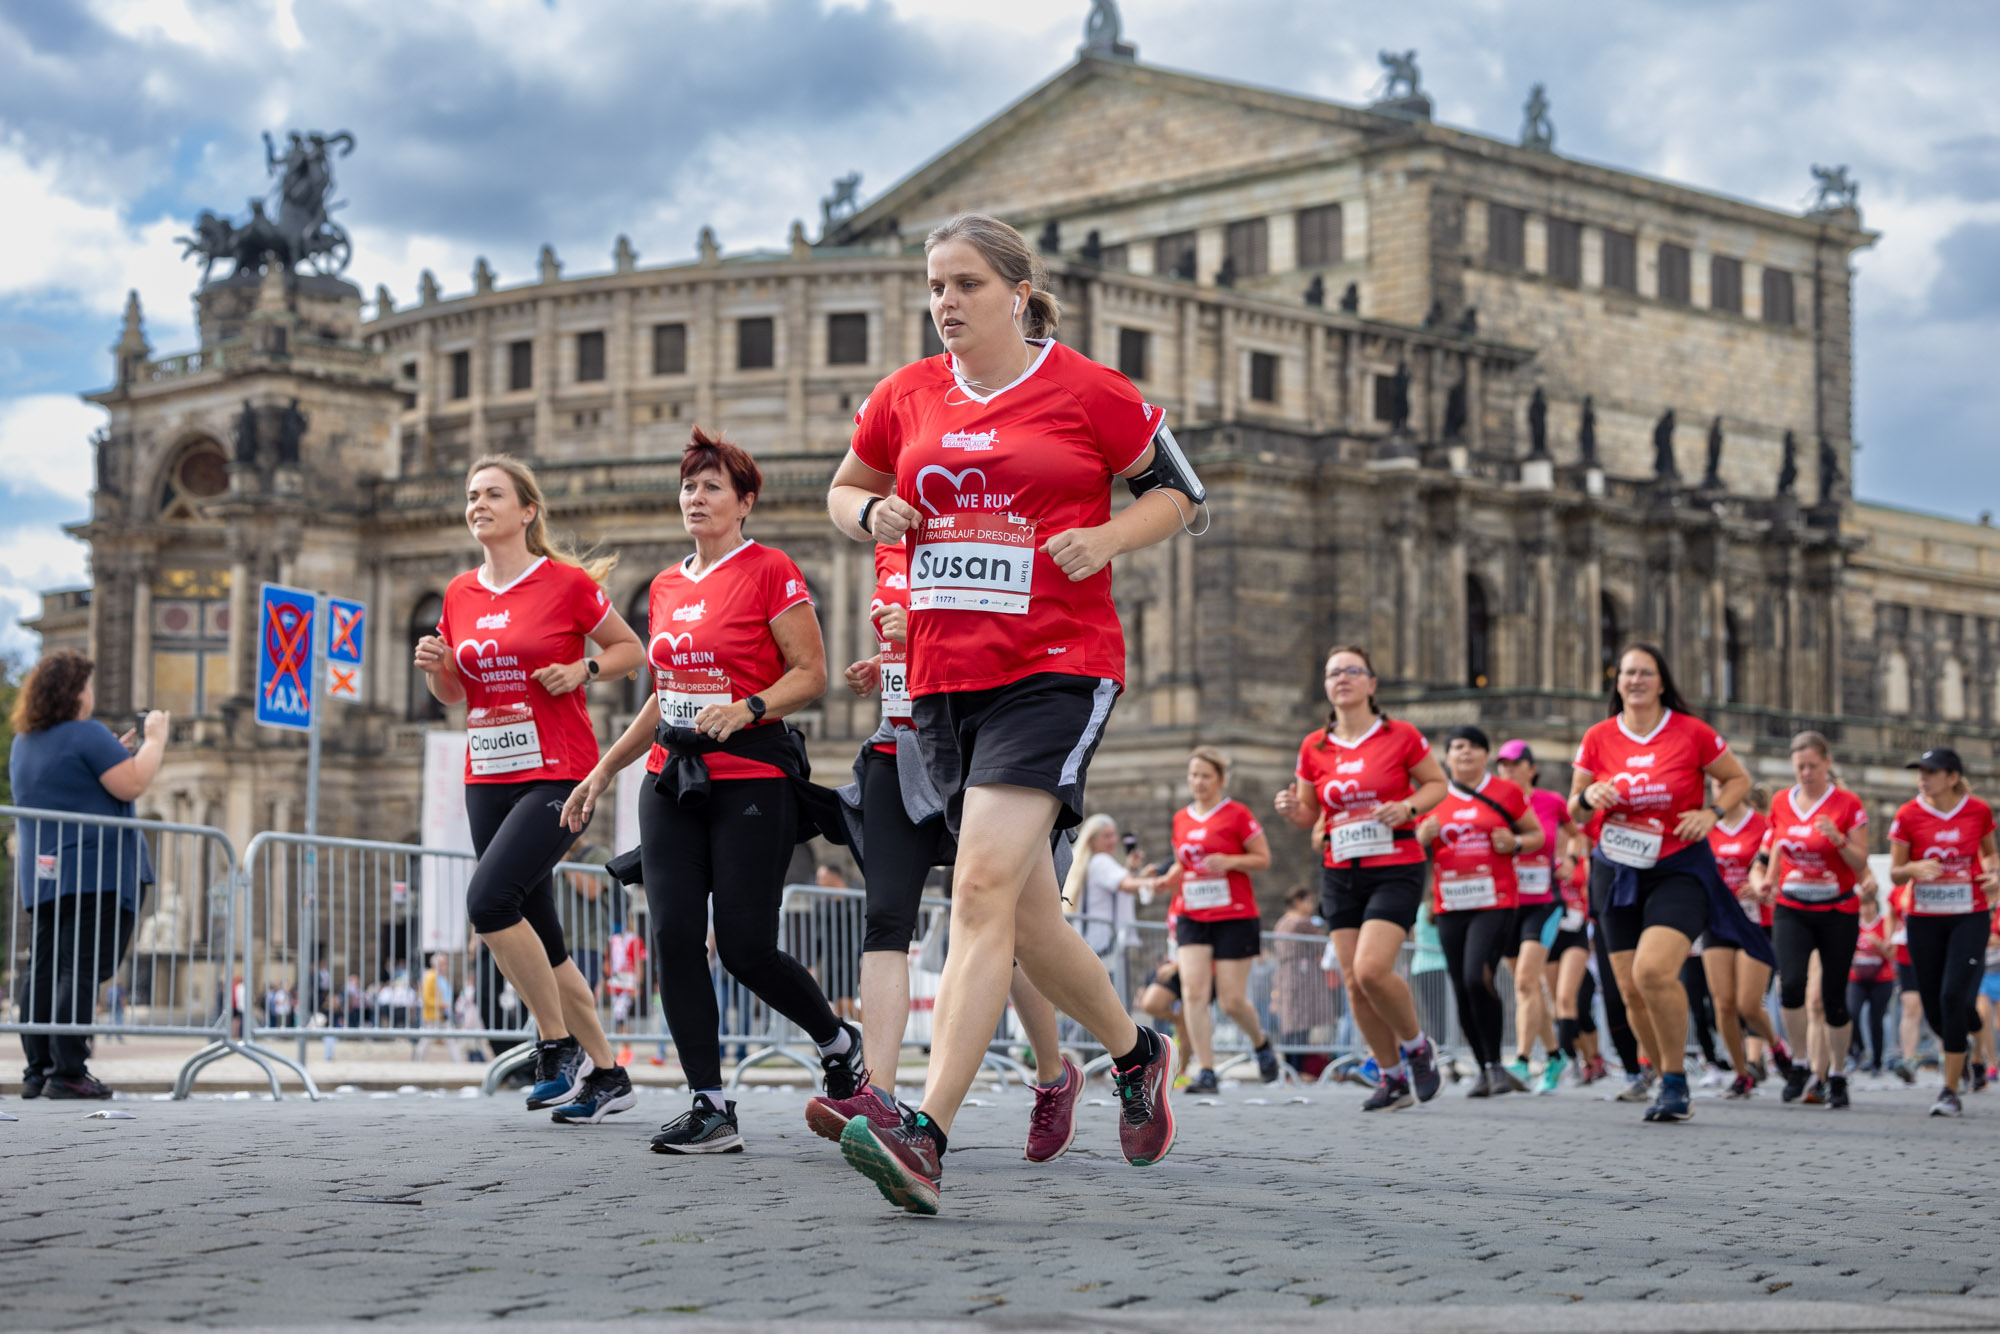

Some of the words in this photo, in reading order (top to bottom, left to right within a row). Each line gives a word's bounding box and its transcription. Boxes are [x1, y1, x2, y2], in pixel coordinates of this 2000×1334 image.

[954, 494, 979, 508] WE
[984, 494, 1015, 508] RUN
[927, 517, 956, 529] REWE
[925, 529, 975, 541] FRAUENLAUF
[977, 529, 1025, 543] DRESDEN
[917, 550, 1011, 582] Susan
[1020, 570, 1029, 583] km
[935, 595, 956, 604] 11771
[477, 657, 494, 669] WE
[496, 656, 518, 667] RUN
[671, 653, 689, 666] WE
[691, 651, 715, 664] RUN
[481, 670, 526, 683] DRESDEN
[687, 683, 724, 692] DRESDEN
[471, 731, 528, 751] Claudia
[1604, 828, 1652, 855] Conny
